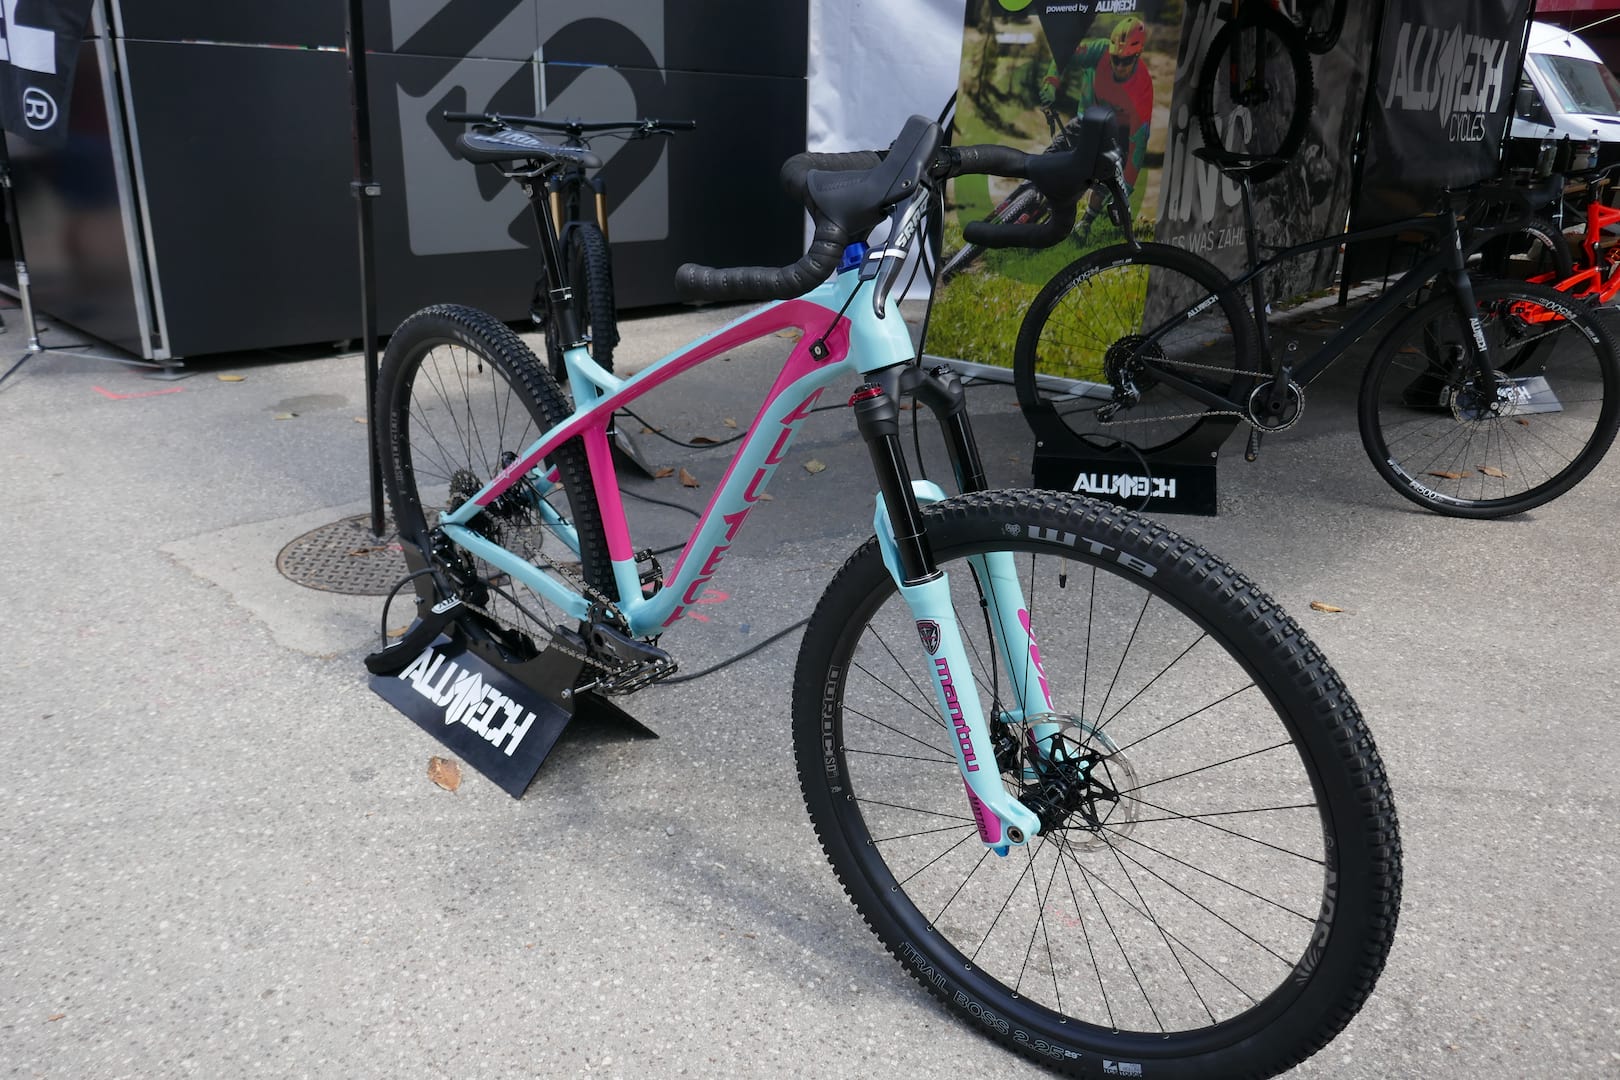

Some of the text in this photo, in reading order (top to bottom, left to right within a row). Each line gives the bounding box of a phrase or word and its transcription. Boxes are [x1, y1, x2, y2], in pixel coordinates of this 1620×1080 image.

[1046, 3, 1089, 14] powered by
[1448, 113, 1486, 142] CYCLES
[1189, 230, 1215, 253] WAS
[1217, 224, 1246, 249] ZÄHL
[1072, 472, 1176, 499] ALUTECH
[1027, 524, 1158, 578] WTB
[398, 646, 538, 757] ALUTECH
[821, 665, 842, 757] DUROC
[934, 656, 980, 773] manitou
[903, 941, 950, 995] TRAIL
[953, 990, 1010, 1036] BOSS
[1012, 1029, 1066, 1062] 2.25
